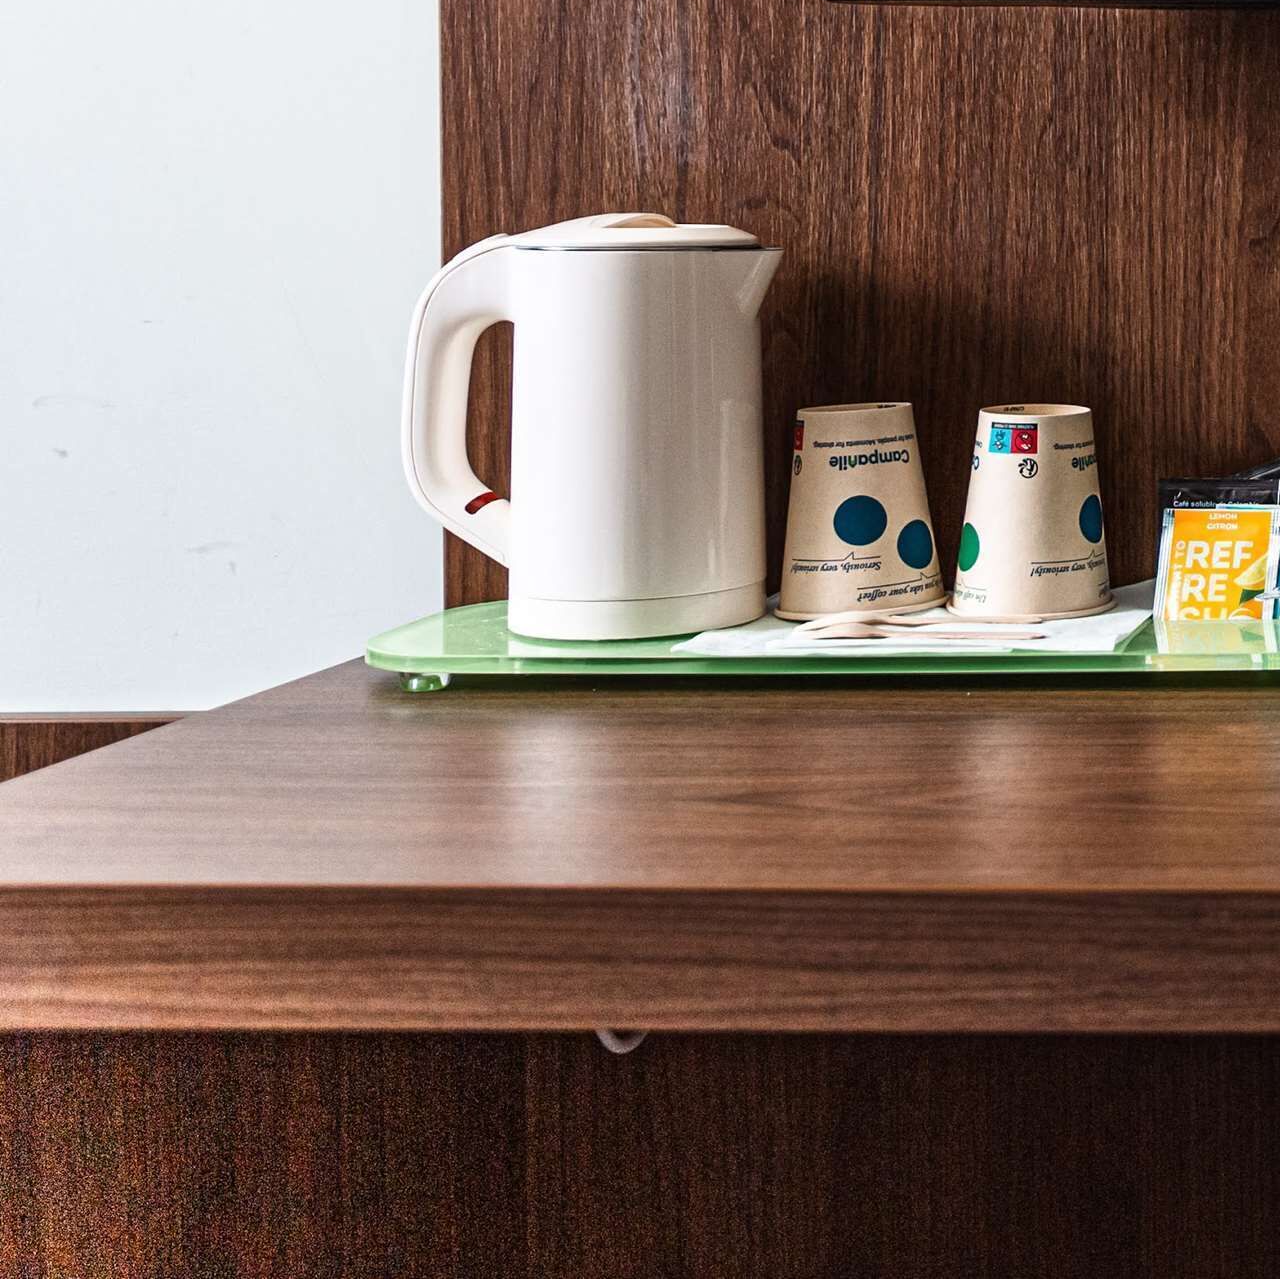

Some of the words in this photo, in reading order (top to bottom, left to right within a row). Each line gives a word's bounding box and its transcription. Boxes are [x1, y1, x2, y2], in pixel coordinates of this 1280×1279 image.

[829, 449, 910, 471] Campanile
[1185, 540, 1255, 569] REF
[820, 562, 838, 573] very
[1181, 573, 1229, 603] RE
